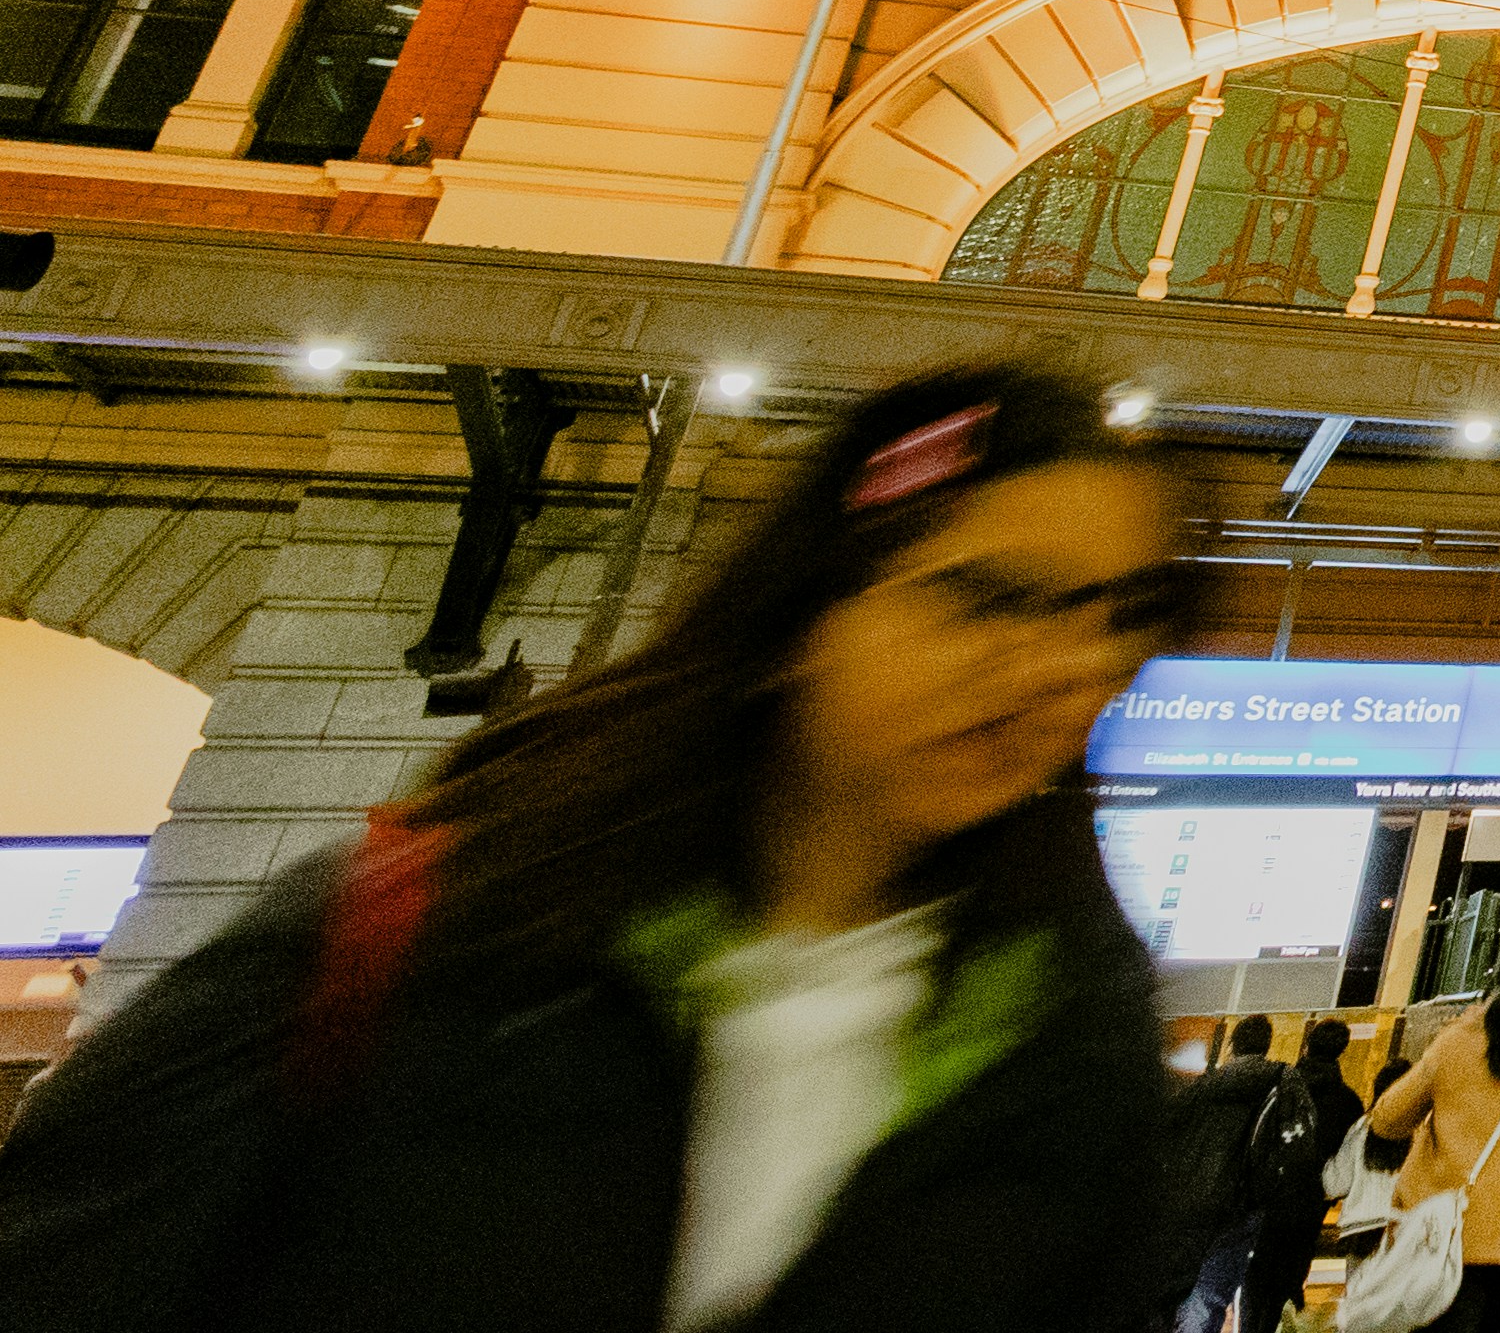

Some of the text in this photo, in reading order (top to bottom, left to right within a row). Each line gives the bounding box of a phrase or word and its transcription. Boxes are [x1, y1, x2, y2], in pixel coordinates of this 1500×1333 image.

[1104, 692, 1462, 723] Flinders Street Station
[1429, 783, 1456, 798] and
